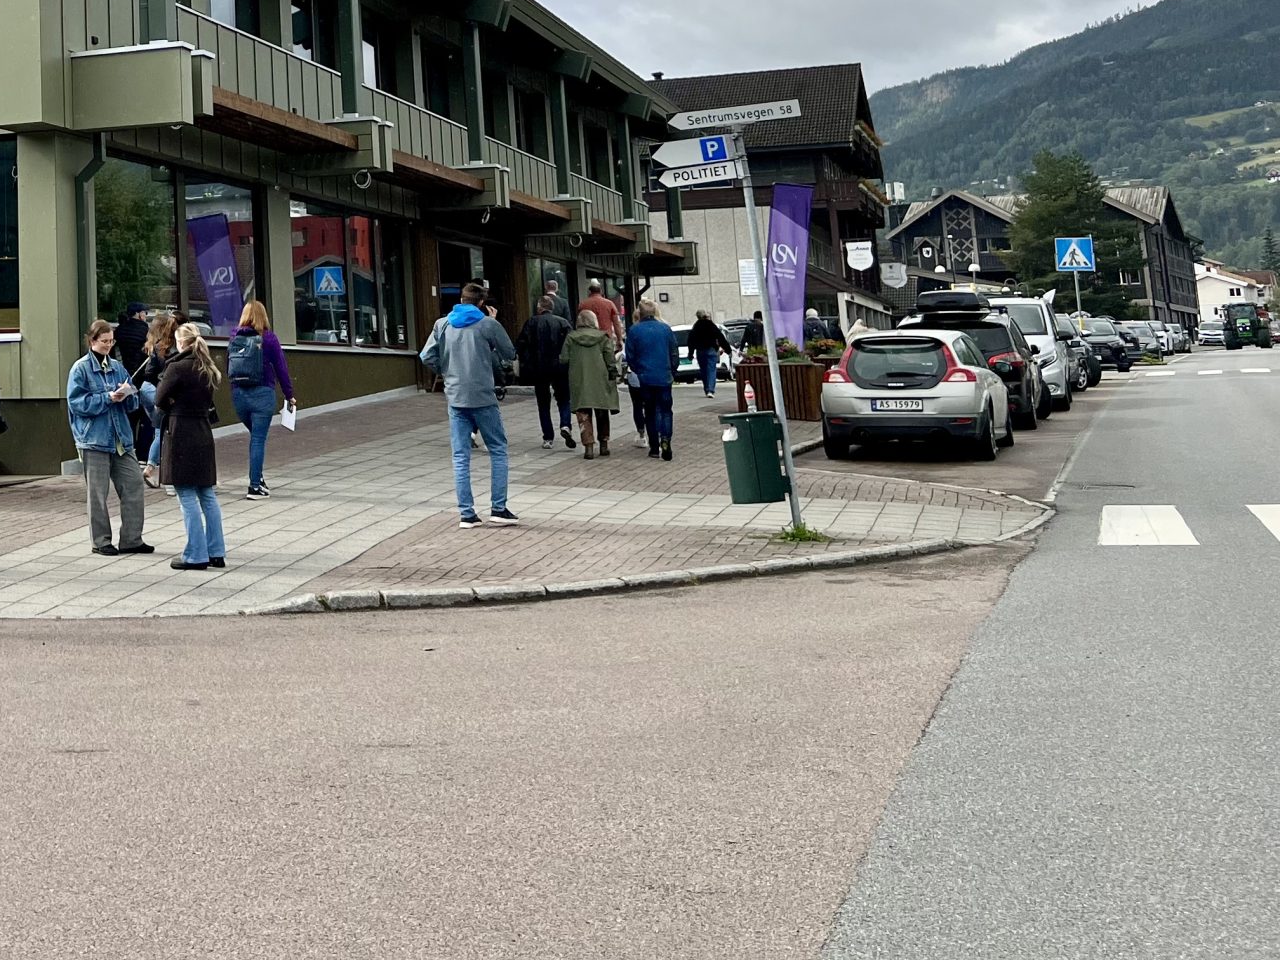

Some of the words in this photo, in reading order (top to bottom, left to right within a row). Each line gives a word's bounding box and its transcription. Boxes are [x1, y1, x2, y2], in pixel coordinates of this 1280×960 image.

[687, 109, 774, 126] Sentrumsvegen
[779, 105, 793, 115] 58
[706, 141, 719, 158] P
[673, 165, 728, 182] POLITIET
